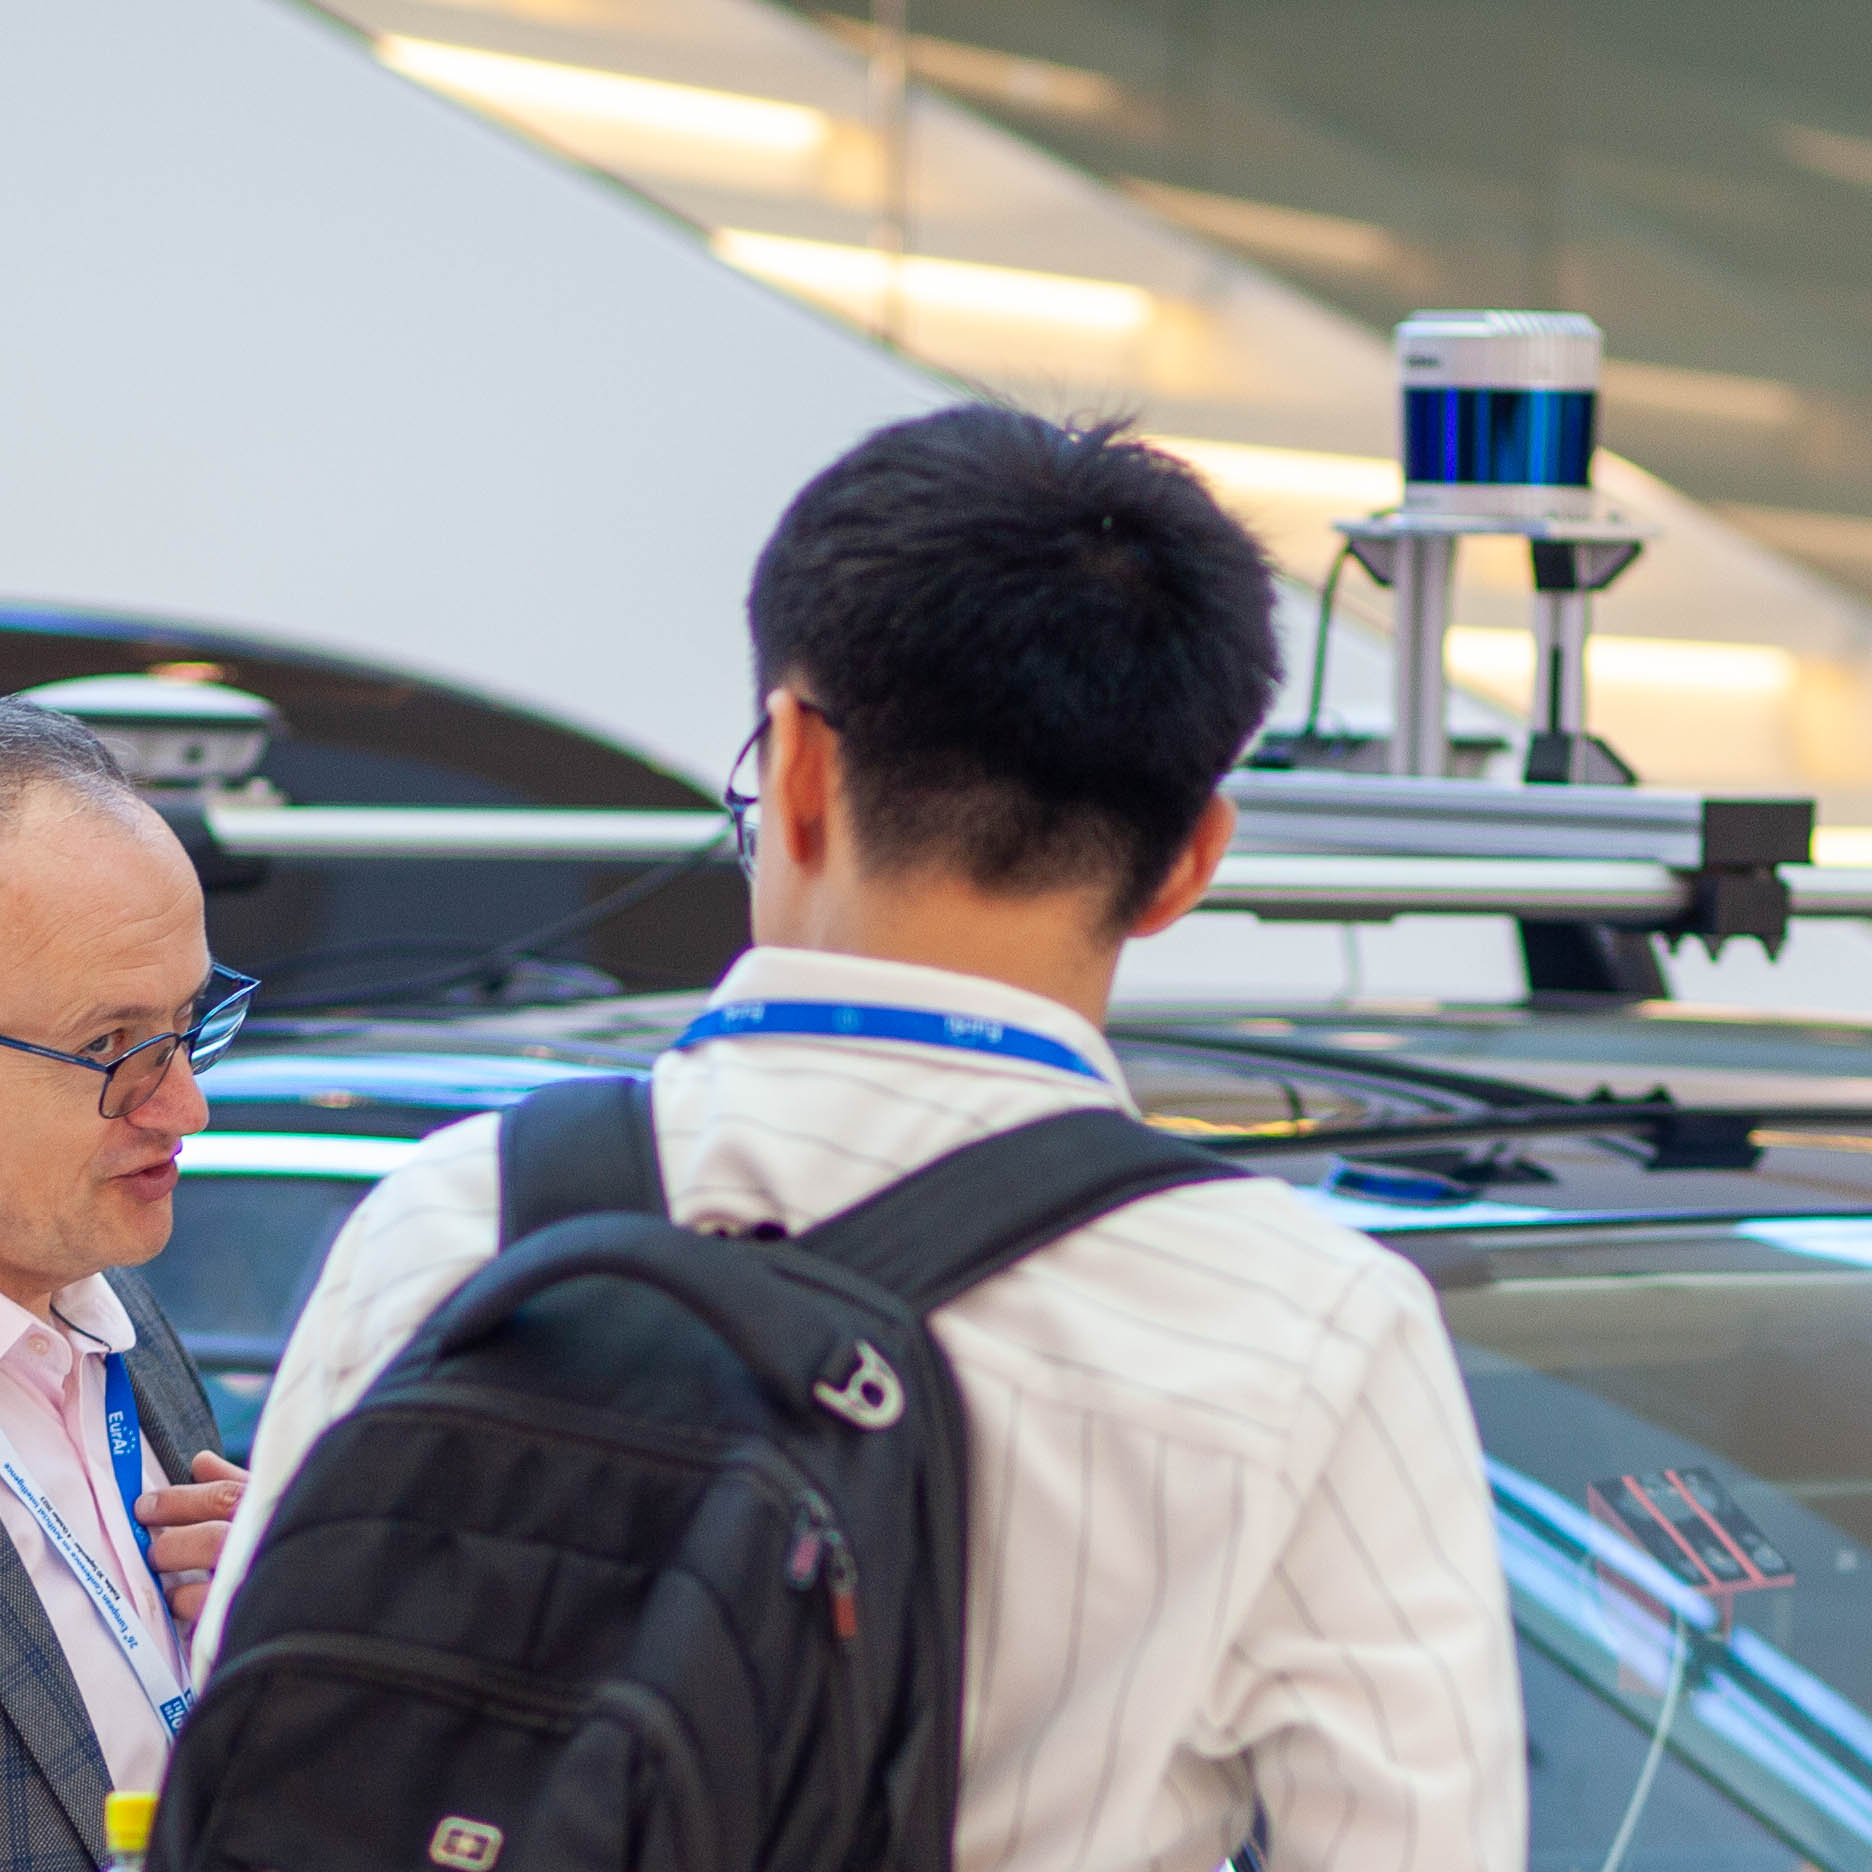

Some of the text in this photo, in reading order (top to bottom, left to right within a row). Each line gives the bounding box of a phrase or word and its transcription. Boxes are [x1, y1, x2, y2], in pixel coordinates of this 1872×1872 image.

[4, 1462, 39, 1509] Intelligence
[37, 1507, 64, 1541] Artificial
[62, 1538, 72, 1552] on
[70, 1551, 105, 1596] Conference
[102, 1593, 129, 1634] European
